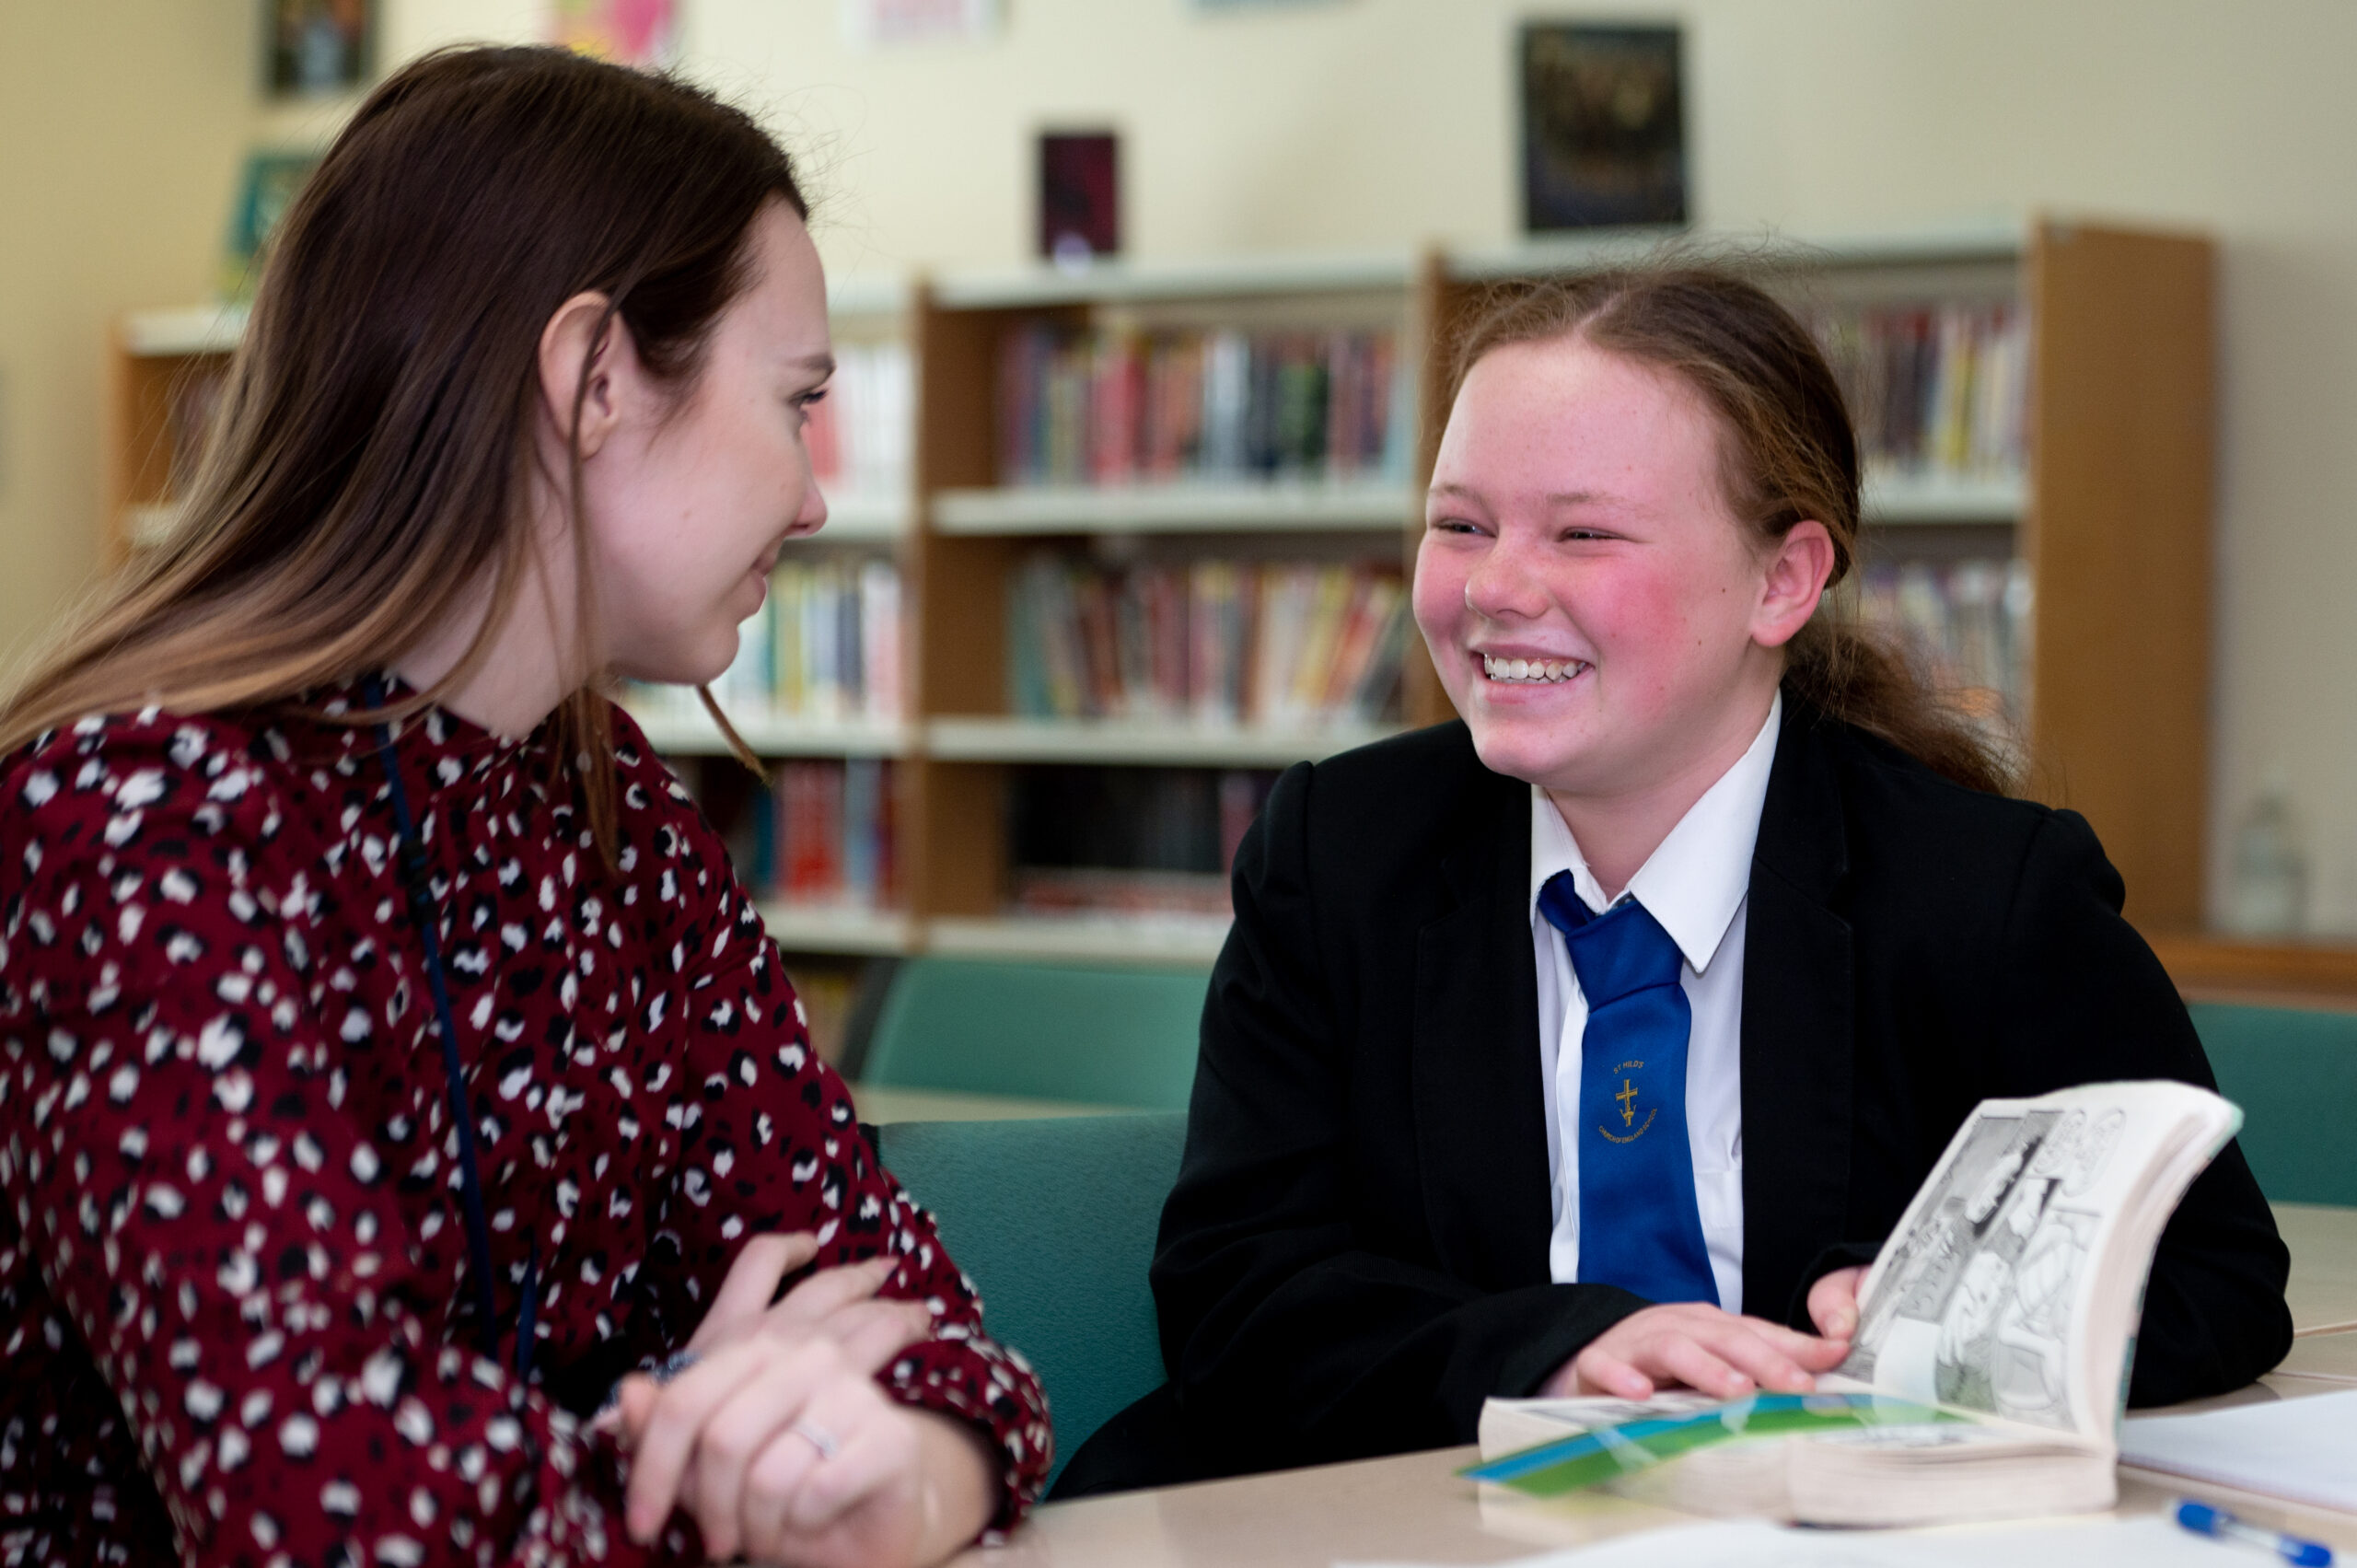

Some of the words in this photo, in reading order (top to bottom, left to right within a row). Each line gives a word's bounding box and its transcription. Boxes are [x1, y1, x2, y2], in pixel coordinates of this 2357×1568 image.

[1613, 1063, 1621, 1074] ST
[1598, 1125, 1616, 1142] CHURCH
[1621, 1128, 1643, 1144] ENGLAND
